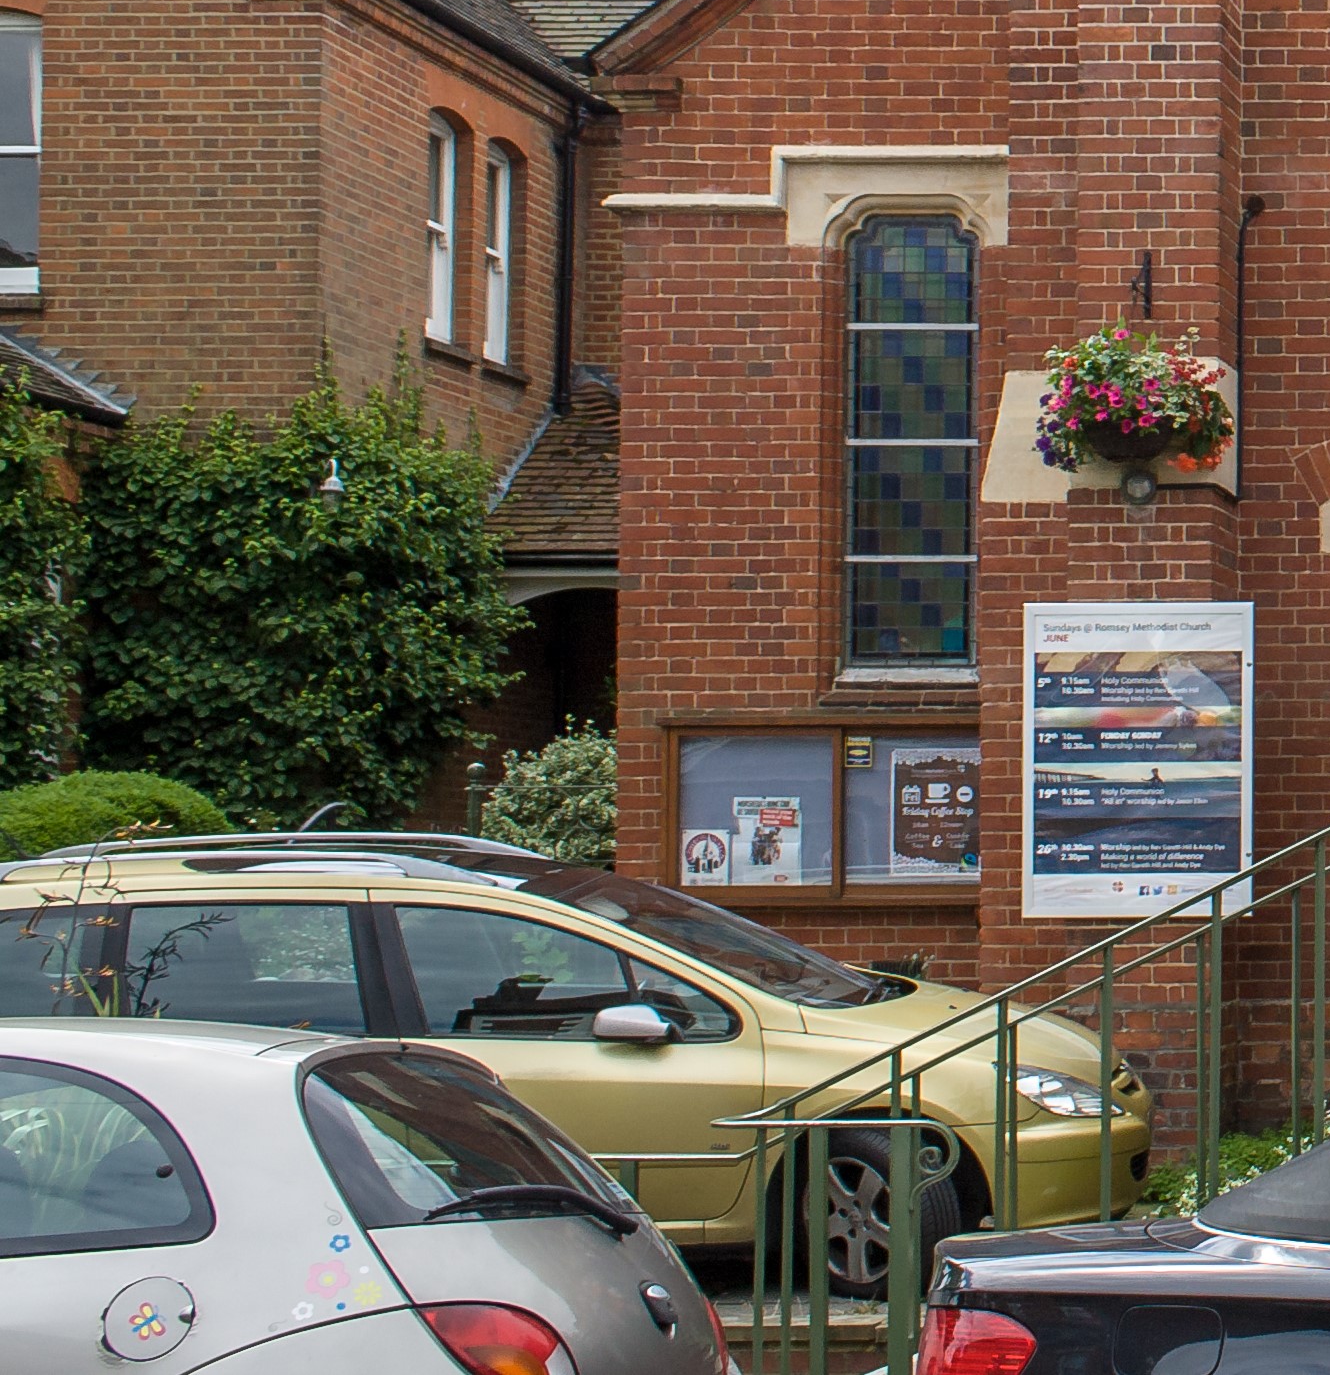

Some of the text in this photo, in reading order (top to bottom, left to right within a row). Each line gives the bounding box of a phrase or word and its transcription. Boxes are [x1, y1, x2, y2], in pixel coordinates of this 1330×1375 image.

[1043, 623, 1082, 633] Sundays
[1095, 623, 1131, 633] Romsey
[1132, 622, 1178, 631] Methodist
[1180, 622, 1212, 631] Church
[1043, 634, 1069, 642] JUNE
[901, 806, 930, 818] Friday
